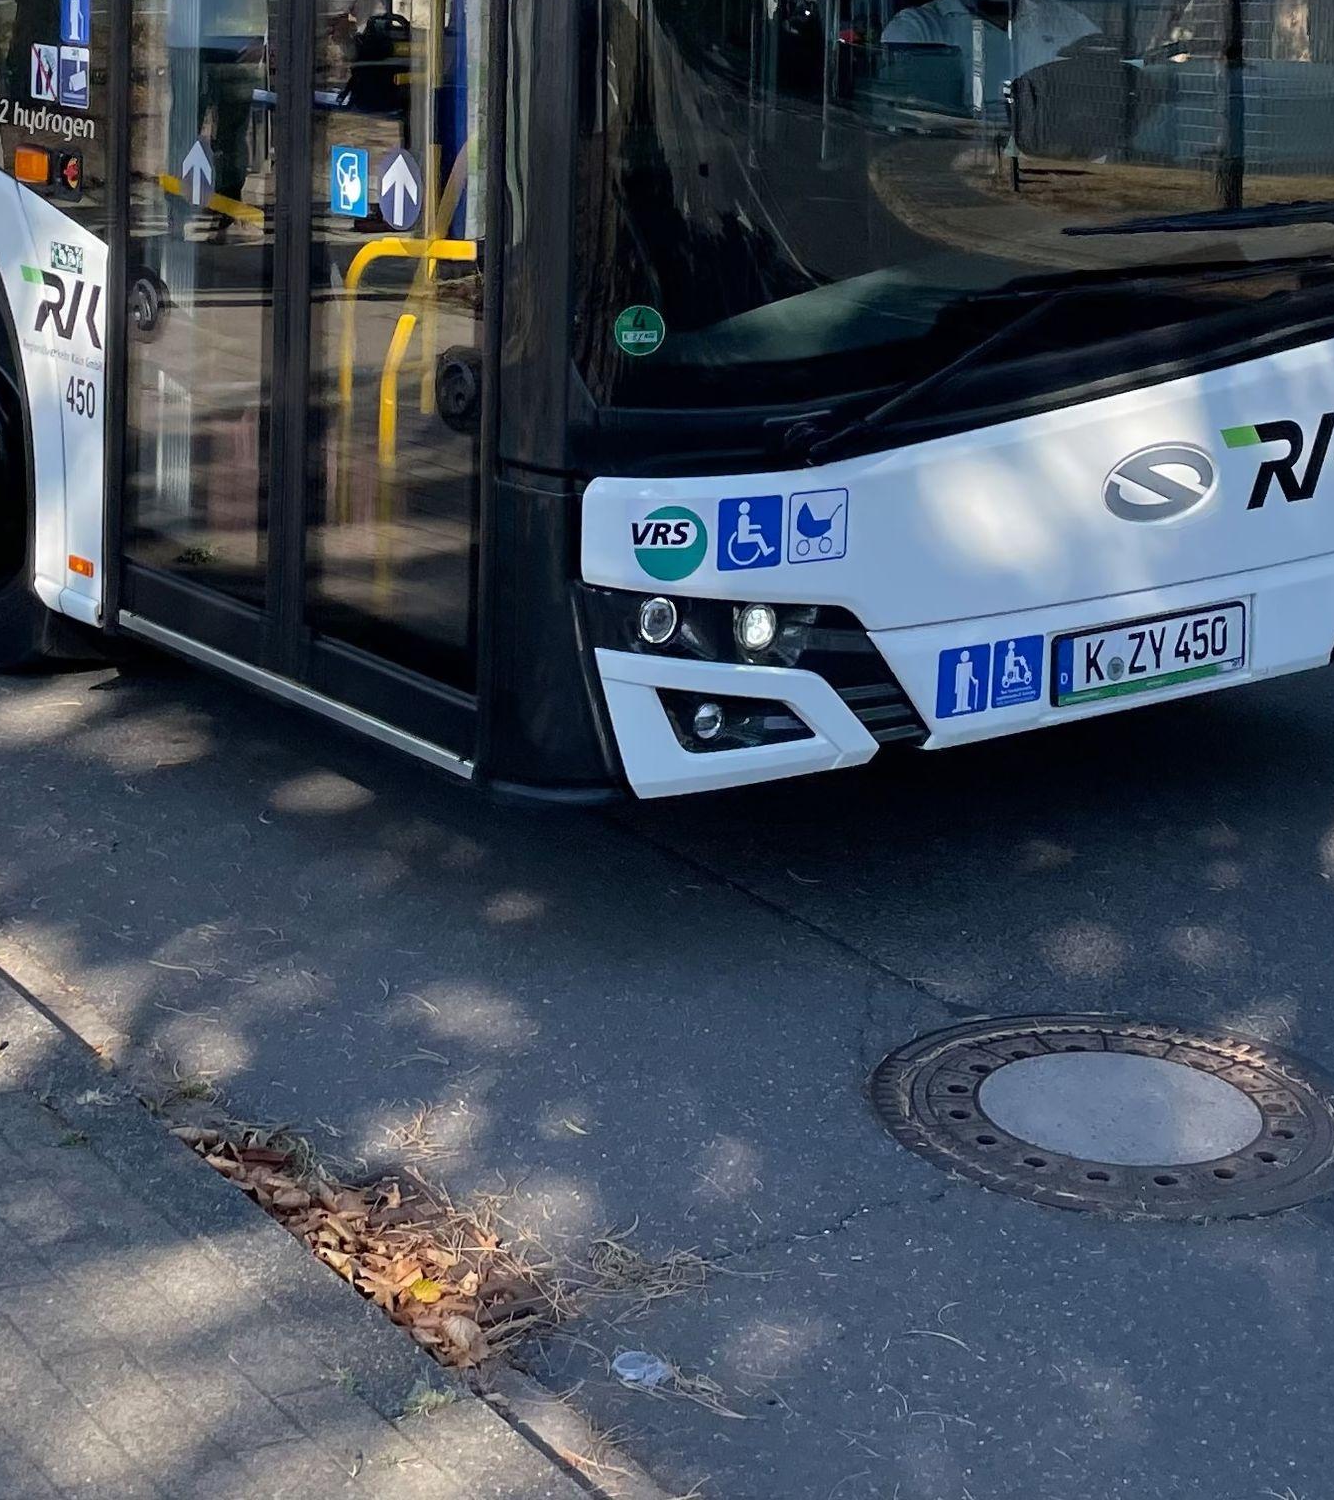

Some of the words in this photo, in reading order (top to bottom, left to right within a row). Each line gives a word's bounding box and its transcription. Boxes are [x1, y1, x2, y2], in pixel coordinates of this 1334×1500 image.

[13, 102, 95, 141] hydrogen
[66, 375, 96, 419] 450
[631, 521, 690, 546] VRS
[1085, 639, 1105, 684] K
[1128, 626, 1166, 675] ZY
[1174, 615, 1228, 664] 450
